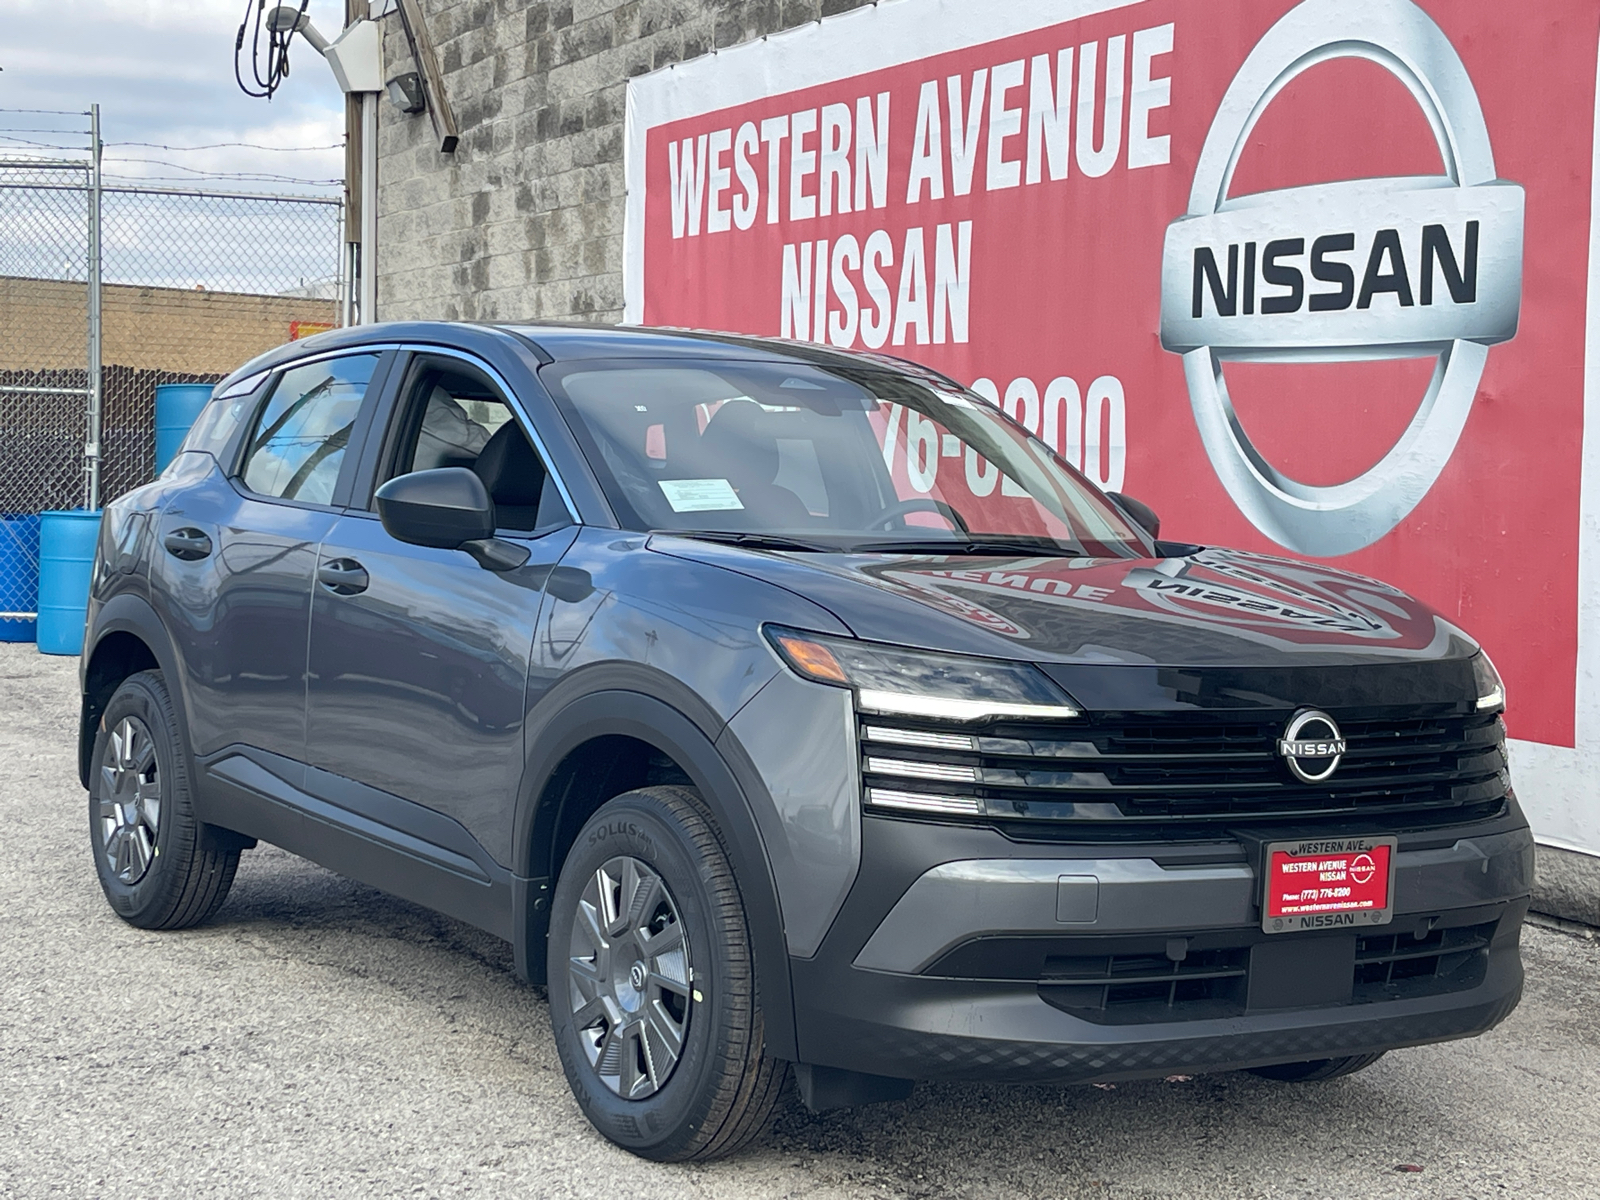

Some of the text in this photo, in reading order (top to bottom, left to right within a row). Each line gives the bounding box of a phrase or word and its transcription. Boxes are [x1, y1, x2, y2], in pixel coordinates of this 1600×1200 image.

[669, 22, 1175, 240] WESTERN AVENUE
[1191, 219, 1480, 319] NISSAN
[781, 219, 973, 348] NISSAN
[1283, 741, 1346, 755] NISSAN
[588, 821, 637, 848] SOLUS
[1298, 839, 1365, 855] WESTERN AVE
[1282, 860, 1347, 874] WESTERN AVENUE
[1349, 864, 1376, 872] NISSAN
[1319, 871, 1347, 882] NISSAN
[1300, 889, 1319, 902] (773)
[1300, 913, 1355, 929] NISSAN
